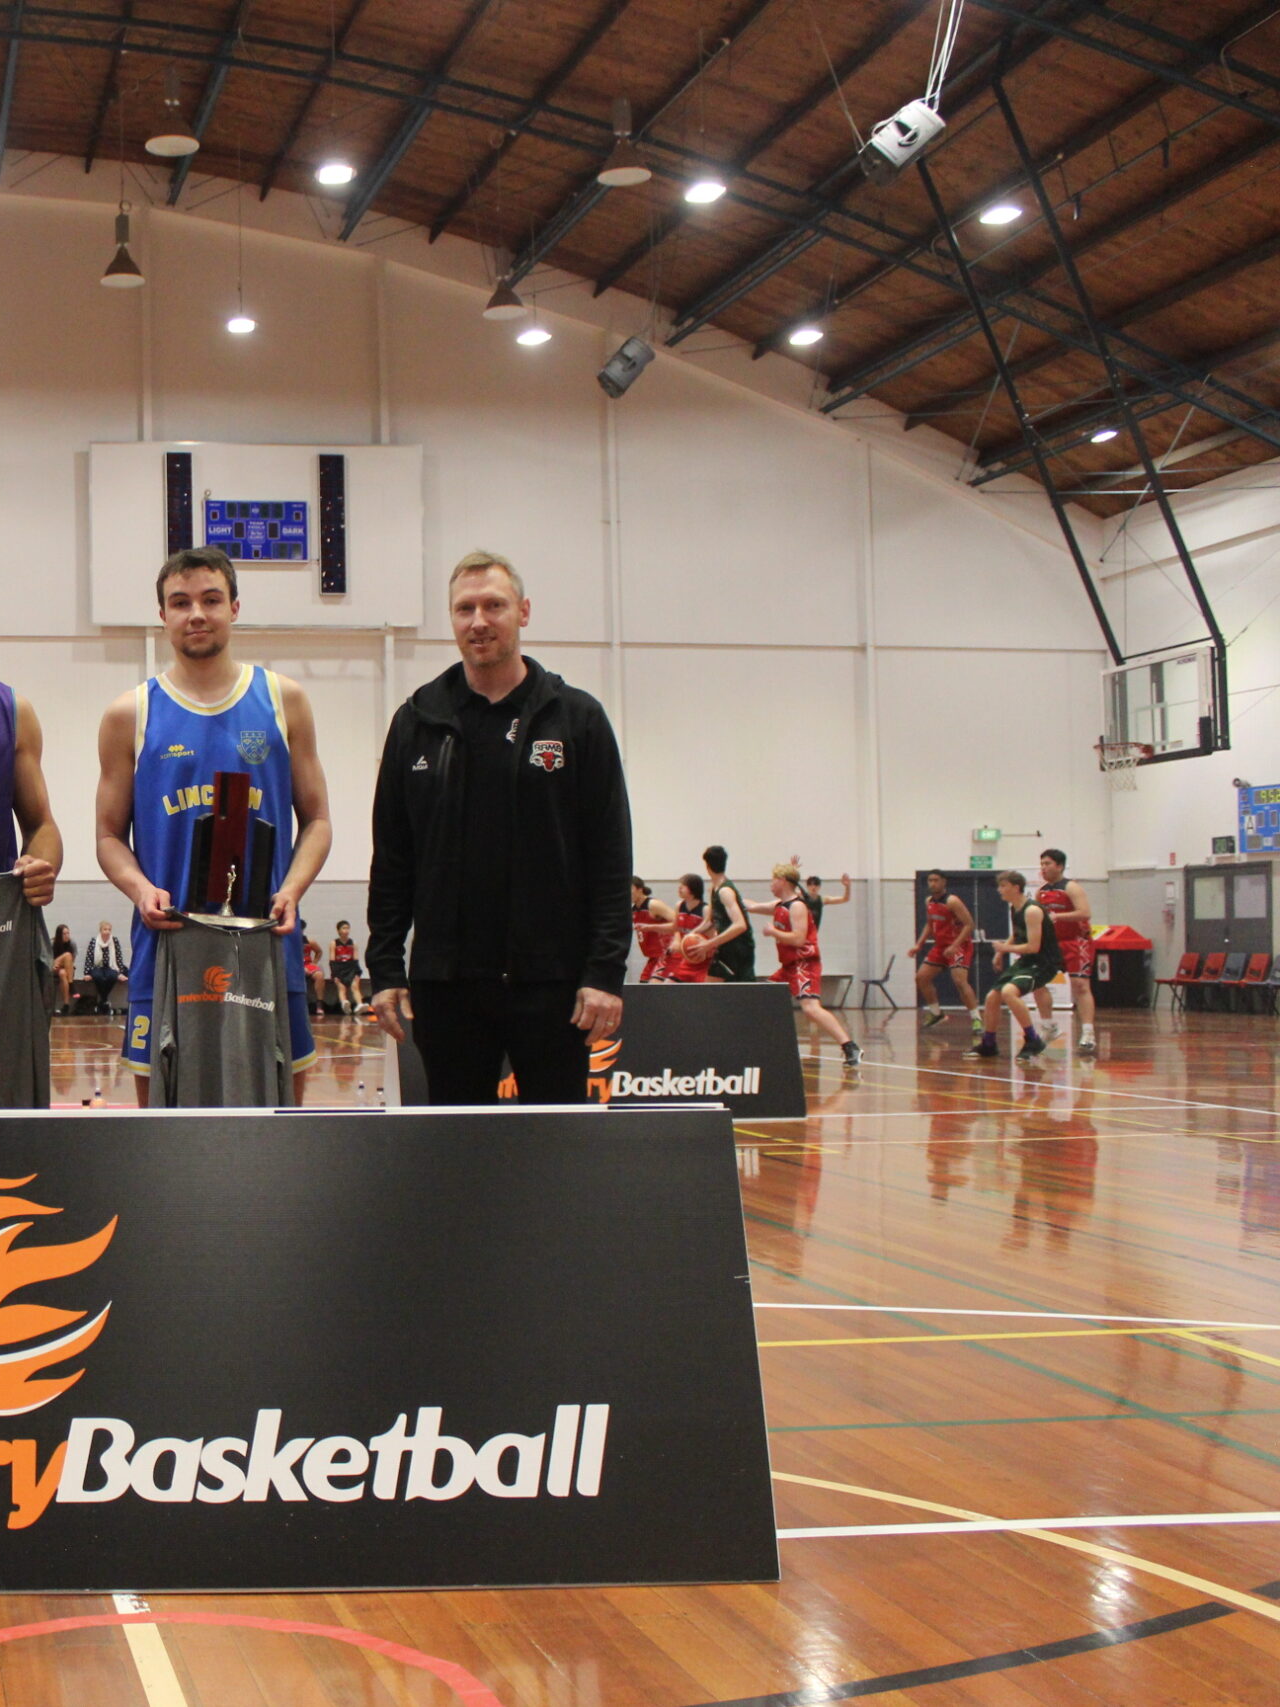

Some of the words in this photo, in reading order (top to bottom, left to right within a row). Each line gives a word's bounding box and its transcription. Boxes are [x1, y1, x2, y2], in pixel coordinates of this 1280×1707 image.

[208, 526, 232, 535] LIGHT
[282, 527, 304, 536] DARK
[162, 785, 263, 816] LINCN
[131, 1015, 150, 1050] 2
